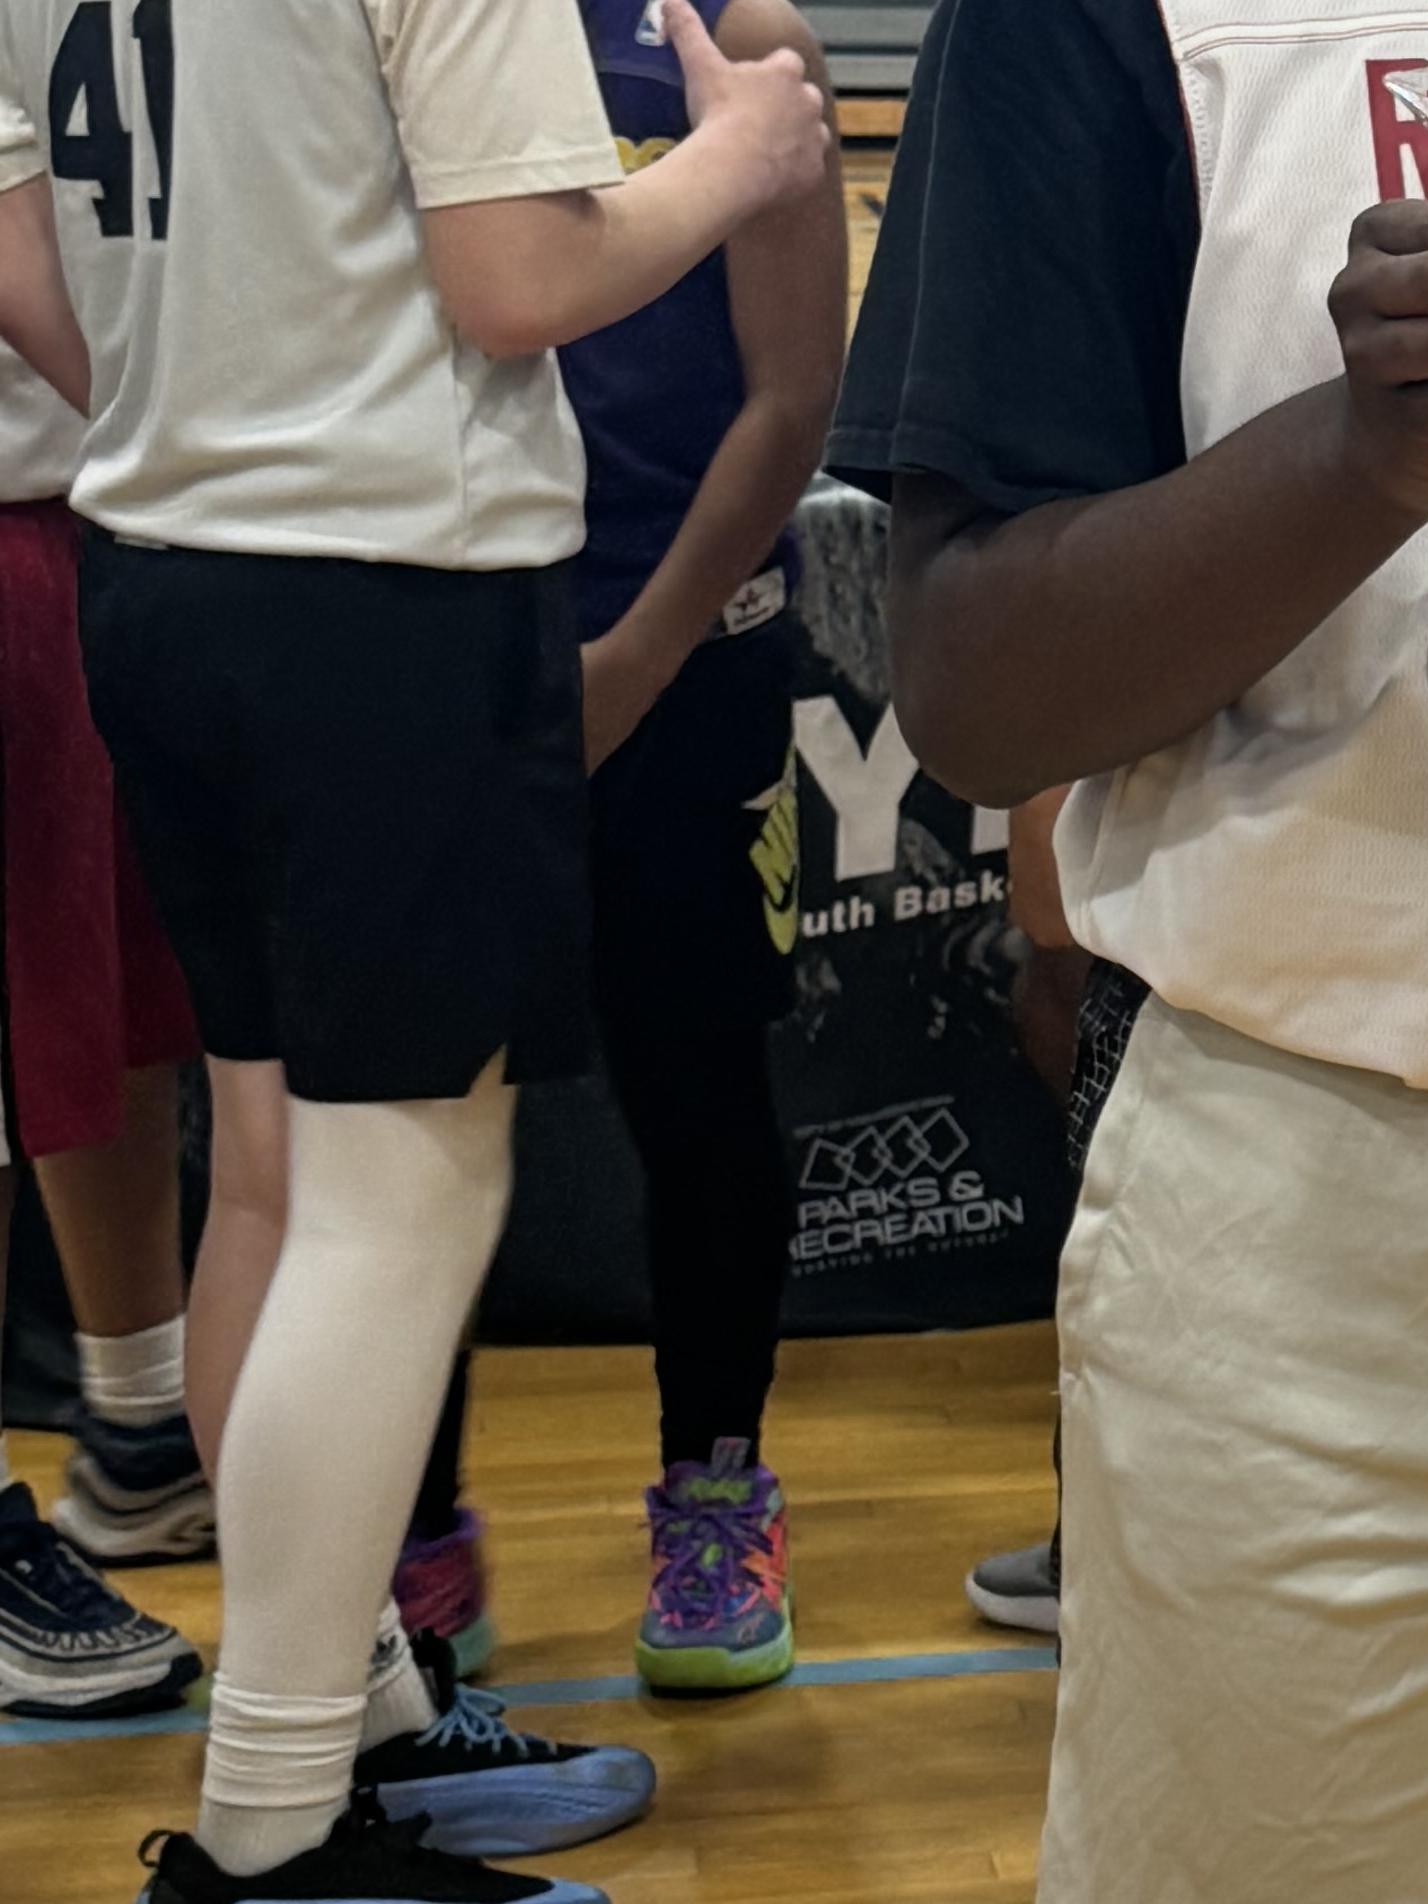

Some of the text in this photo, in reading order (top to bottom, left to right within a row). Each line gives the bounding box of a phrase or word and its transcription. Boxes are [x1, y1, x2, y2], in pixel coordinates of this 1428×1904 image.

[894, 869, 1013, 921] Bask
[798, 1170, 984, 1229] PARKS &
